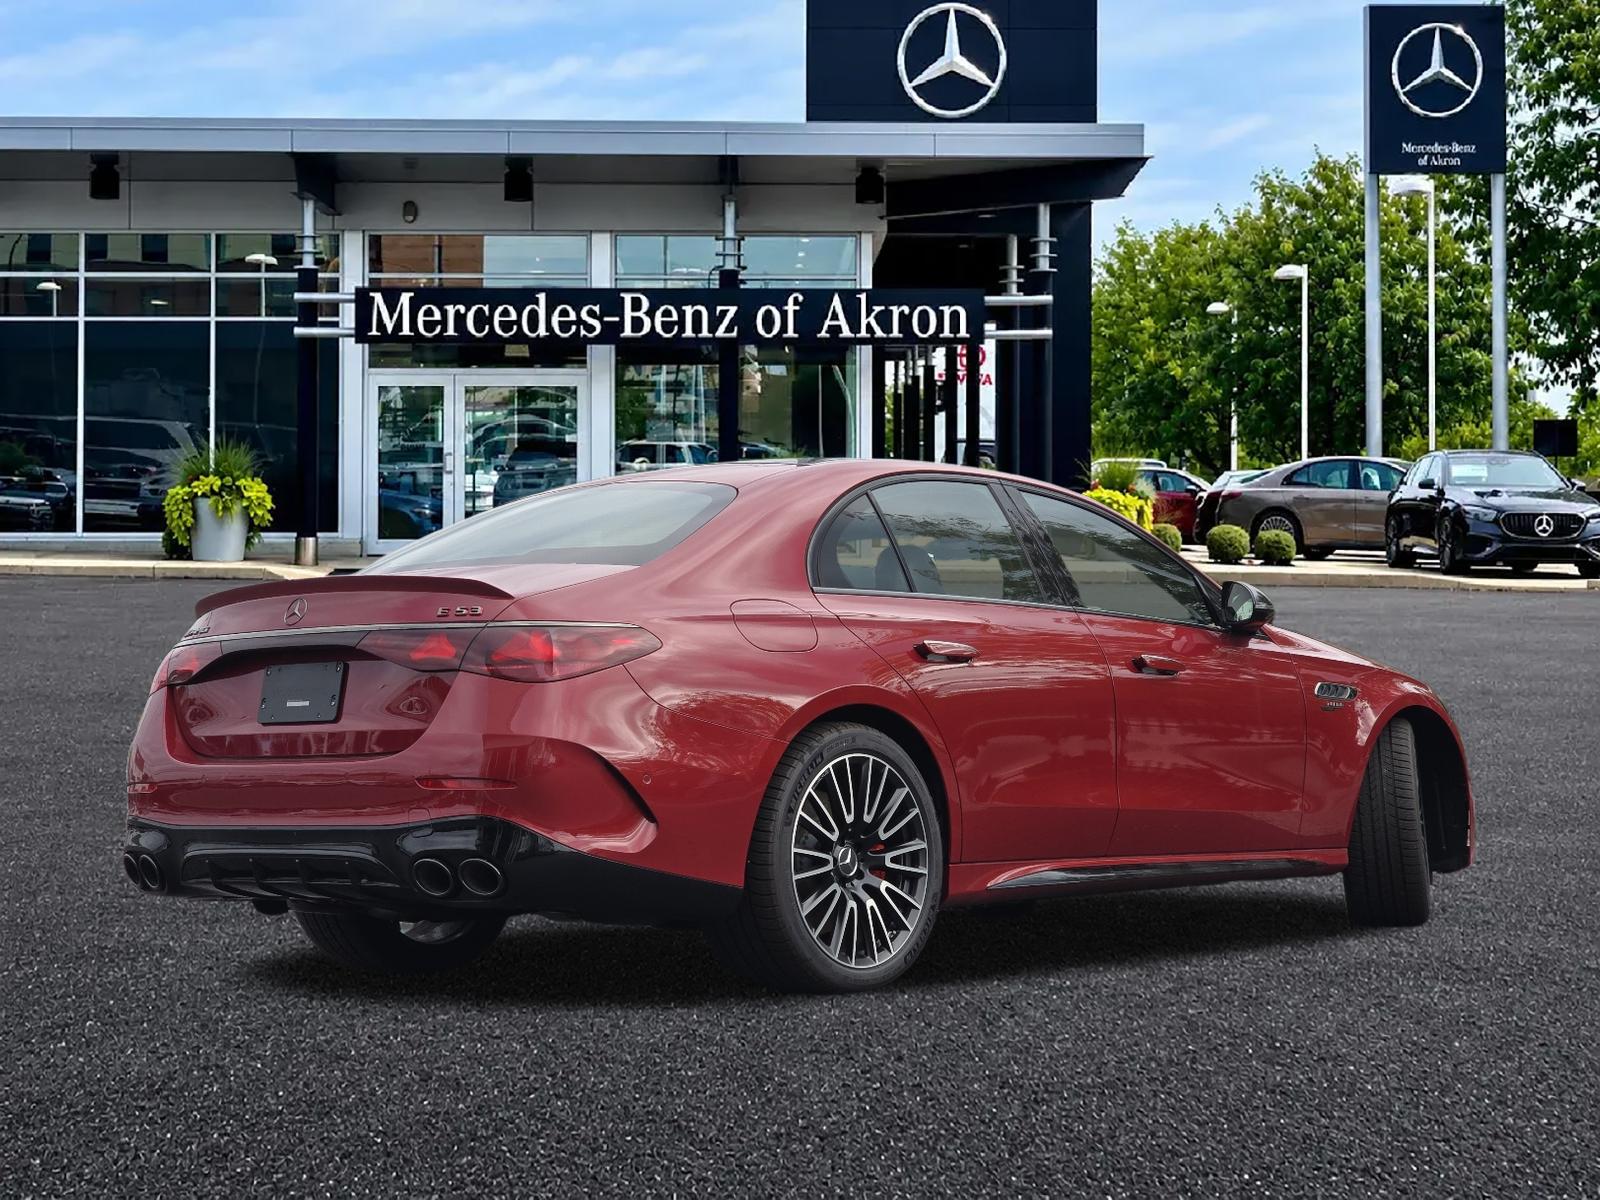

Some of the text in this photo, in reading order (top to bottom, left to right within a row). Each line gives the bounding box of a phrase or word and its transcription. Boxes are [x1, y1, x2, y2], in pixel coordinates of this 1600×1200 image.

[1401, 141, 1476, 153] Mercedes-Benz
[1417, 154, 1461, 166] of Akron
[367, 291, 971, 339] Mercedes-Benz of Akron
[437, 605, 483, 617] E 53
